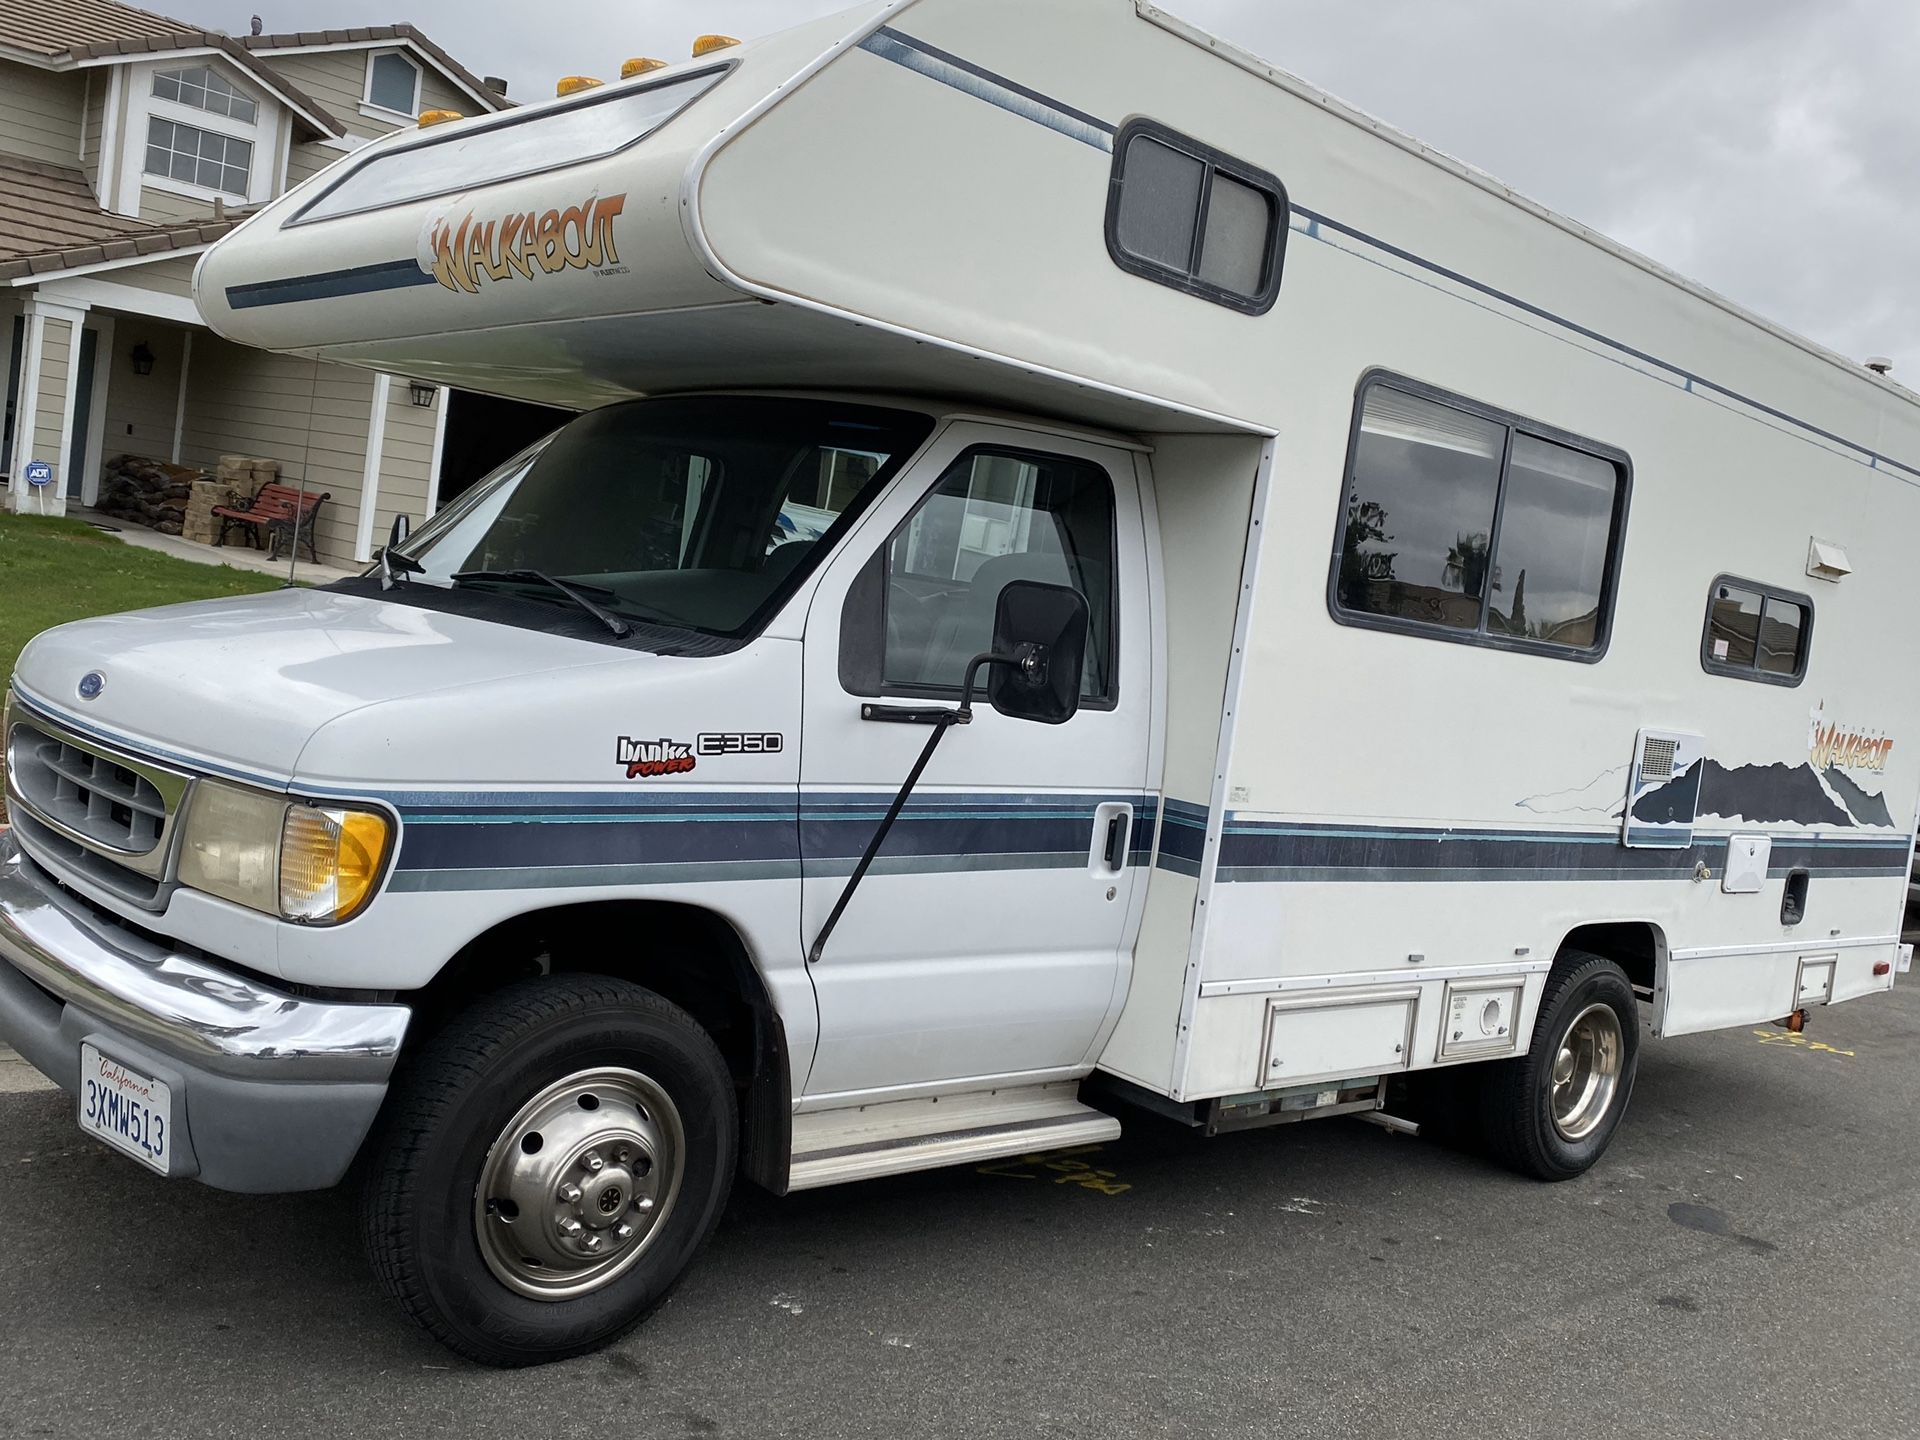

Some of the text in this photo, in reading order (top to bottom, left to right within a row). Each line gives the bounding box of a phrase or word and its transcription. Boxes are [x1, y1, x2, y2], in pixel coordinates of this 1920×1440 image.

[430, 192, 627, 294] WALKABOUT
[30, 468, 49, 478] ADT
[627, 756, 695, 778] POWER
[1810, 720, 1894, 771] WALKABOUT
[100, 1059, 155, 1102] California
[86, 1079, 164, 1156] 3XMW513
